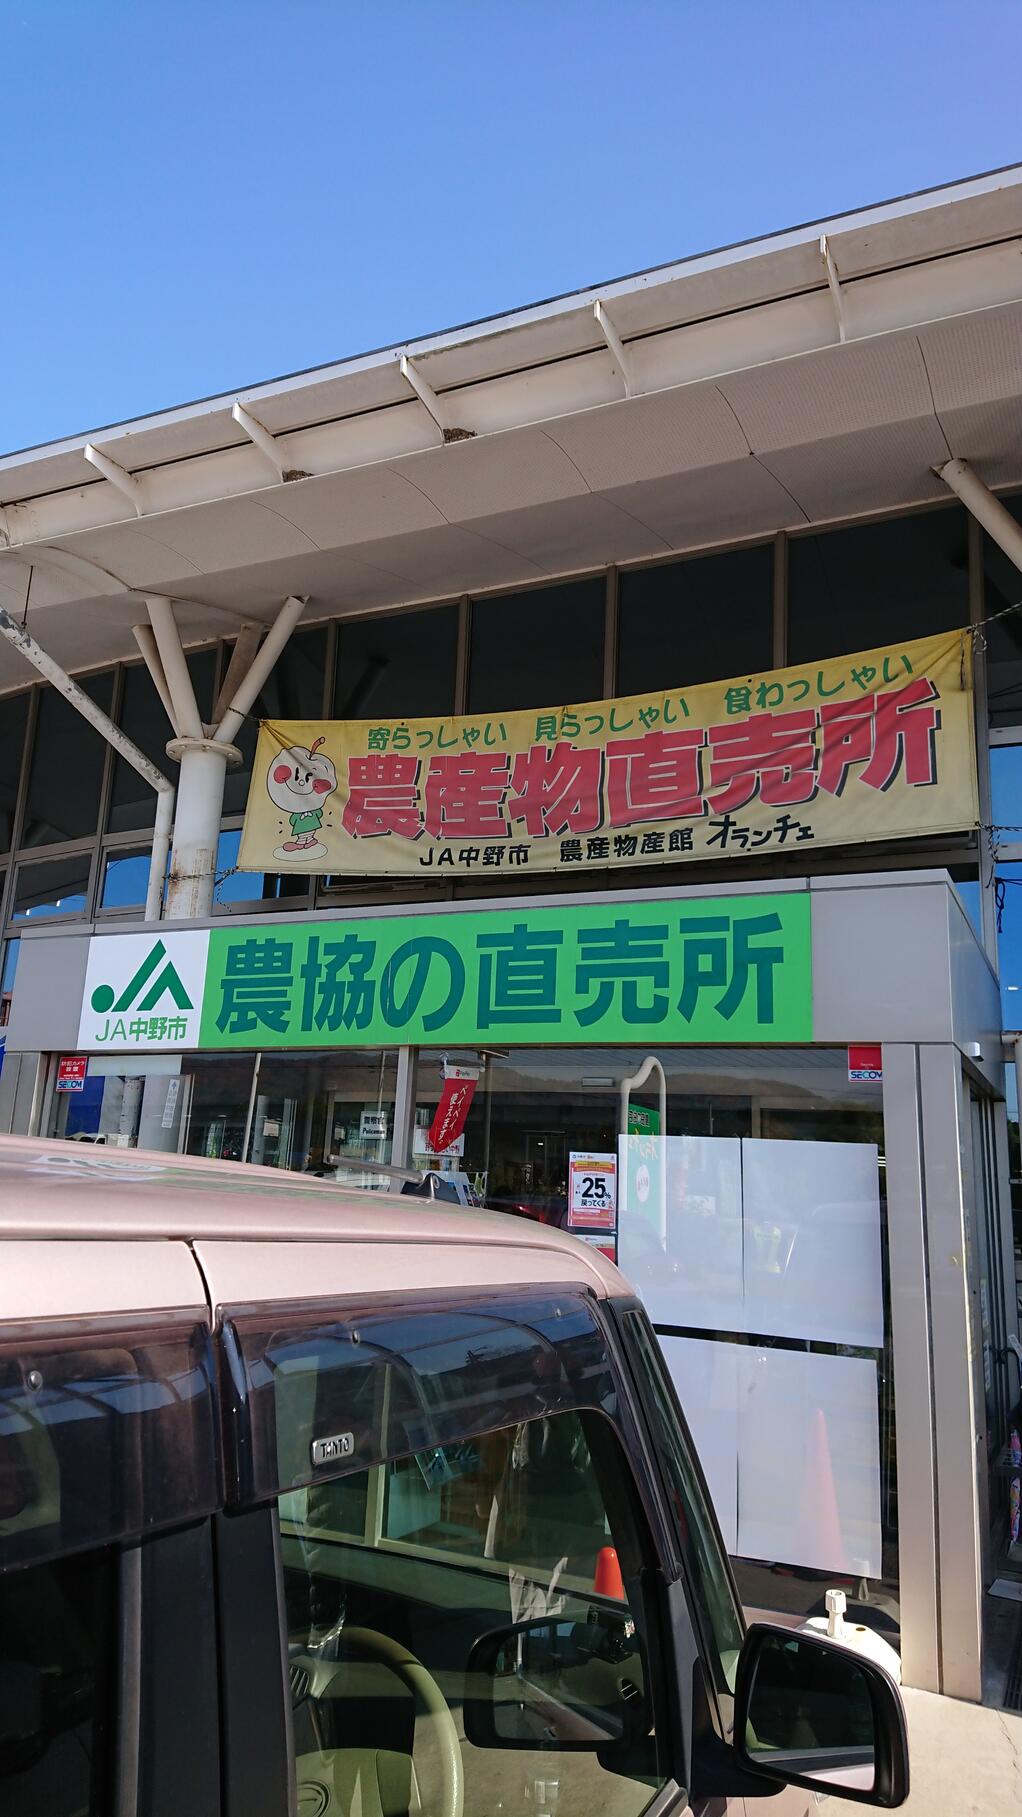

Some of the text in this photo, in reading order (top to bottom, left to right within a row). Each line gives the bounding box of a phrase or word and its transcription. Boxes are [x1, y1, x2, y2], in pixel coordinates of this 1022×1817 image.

[367, 655, 914, 751] 寄らっしゃい 見らっしゃい 食わっしゃい
[341, 677, 941, 840] 農産物直売所
[420, 814, 815, 868] JA中野市 農産物産館 オランチェ
[216, 912, 785, 1034] 農協の直売所
[95, 1015, 188, 1041] JA中野市
